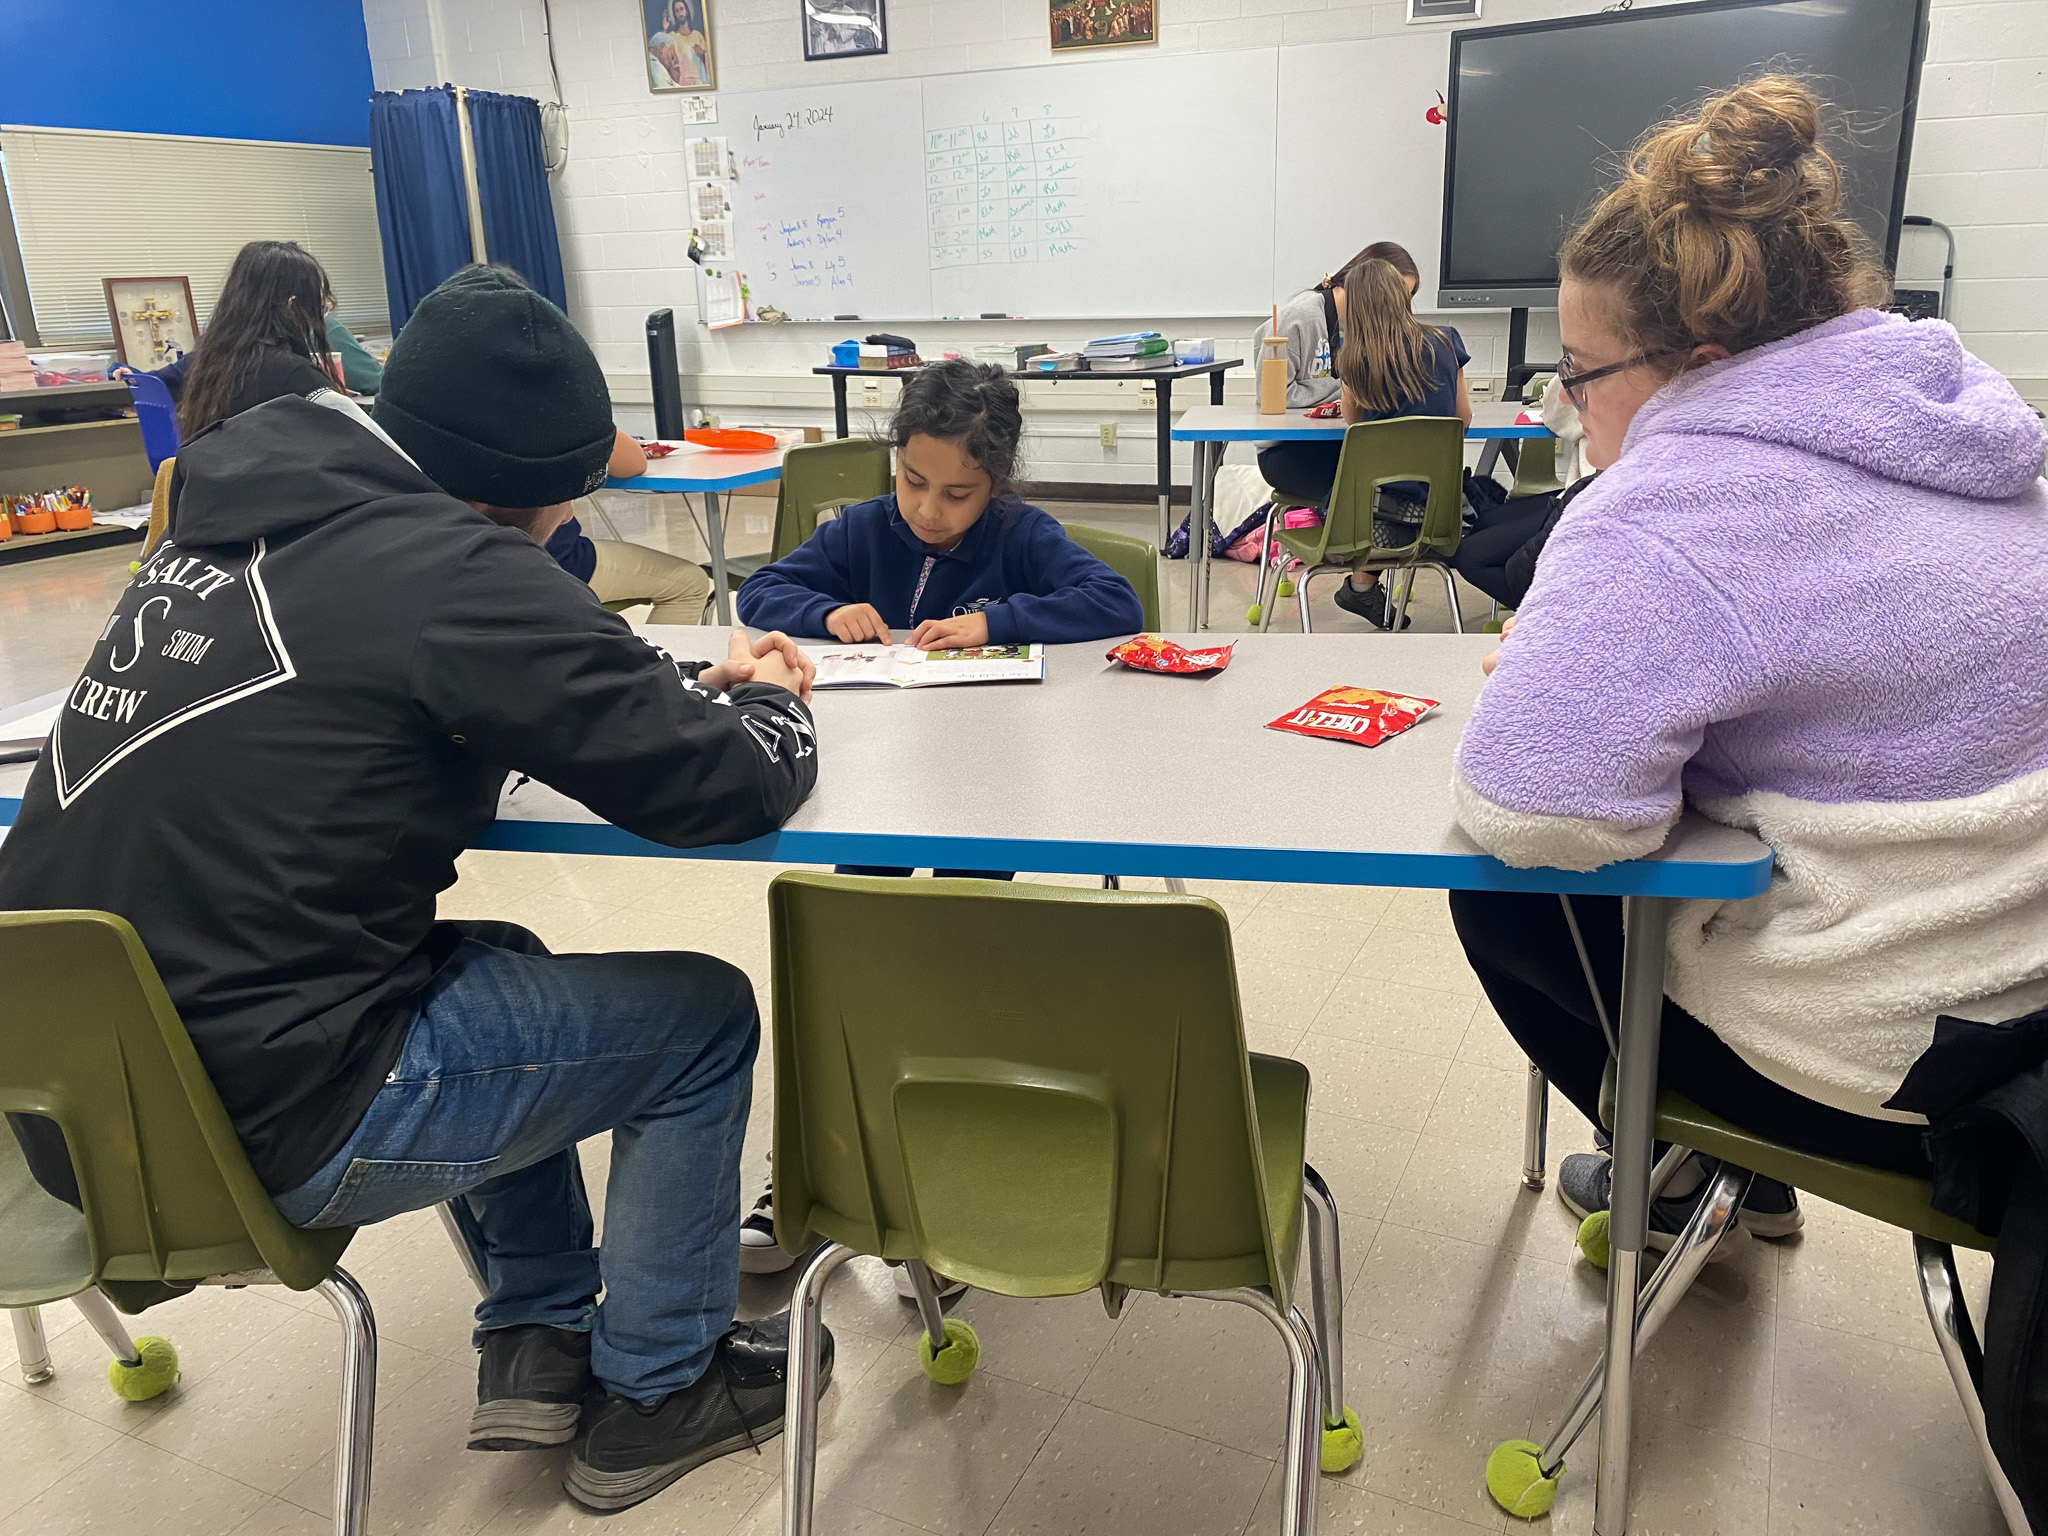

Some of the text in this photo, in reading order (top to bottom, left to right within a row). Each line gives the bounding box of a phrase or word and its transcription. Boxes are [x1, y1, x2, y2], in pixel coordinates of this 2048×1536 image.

[753, 114, 784, 142] January
[805, 105, 834, 126] 2024
[982, 103, 1052, 122] 6 7 8
[1045, 143, 1065, 159] ELA
[1044, 199, 1067, 215] Math
[1048, 240, 1078, 257] Math
[138, 556, 235, 601] SALTY
[160, 629, 215, 665] SWIM
[69, 675, 148, 724] CREW
